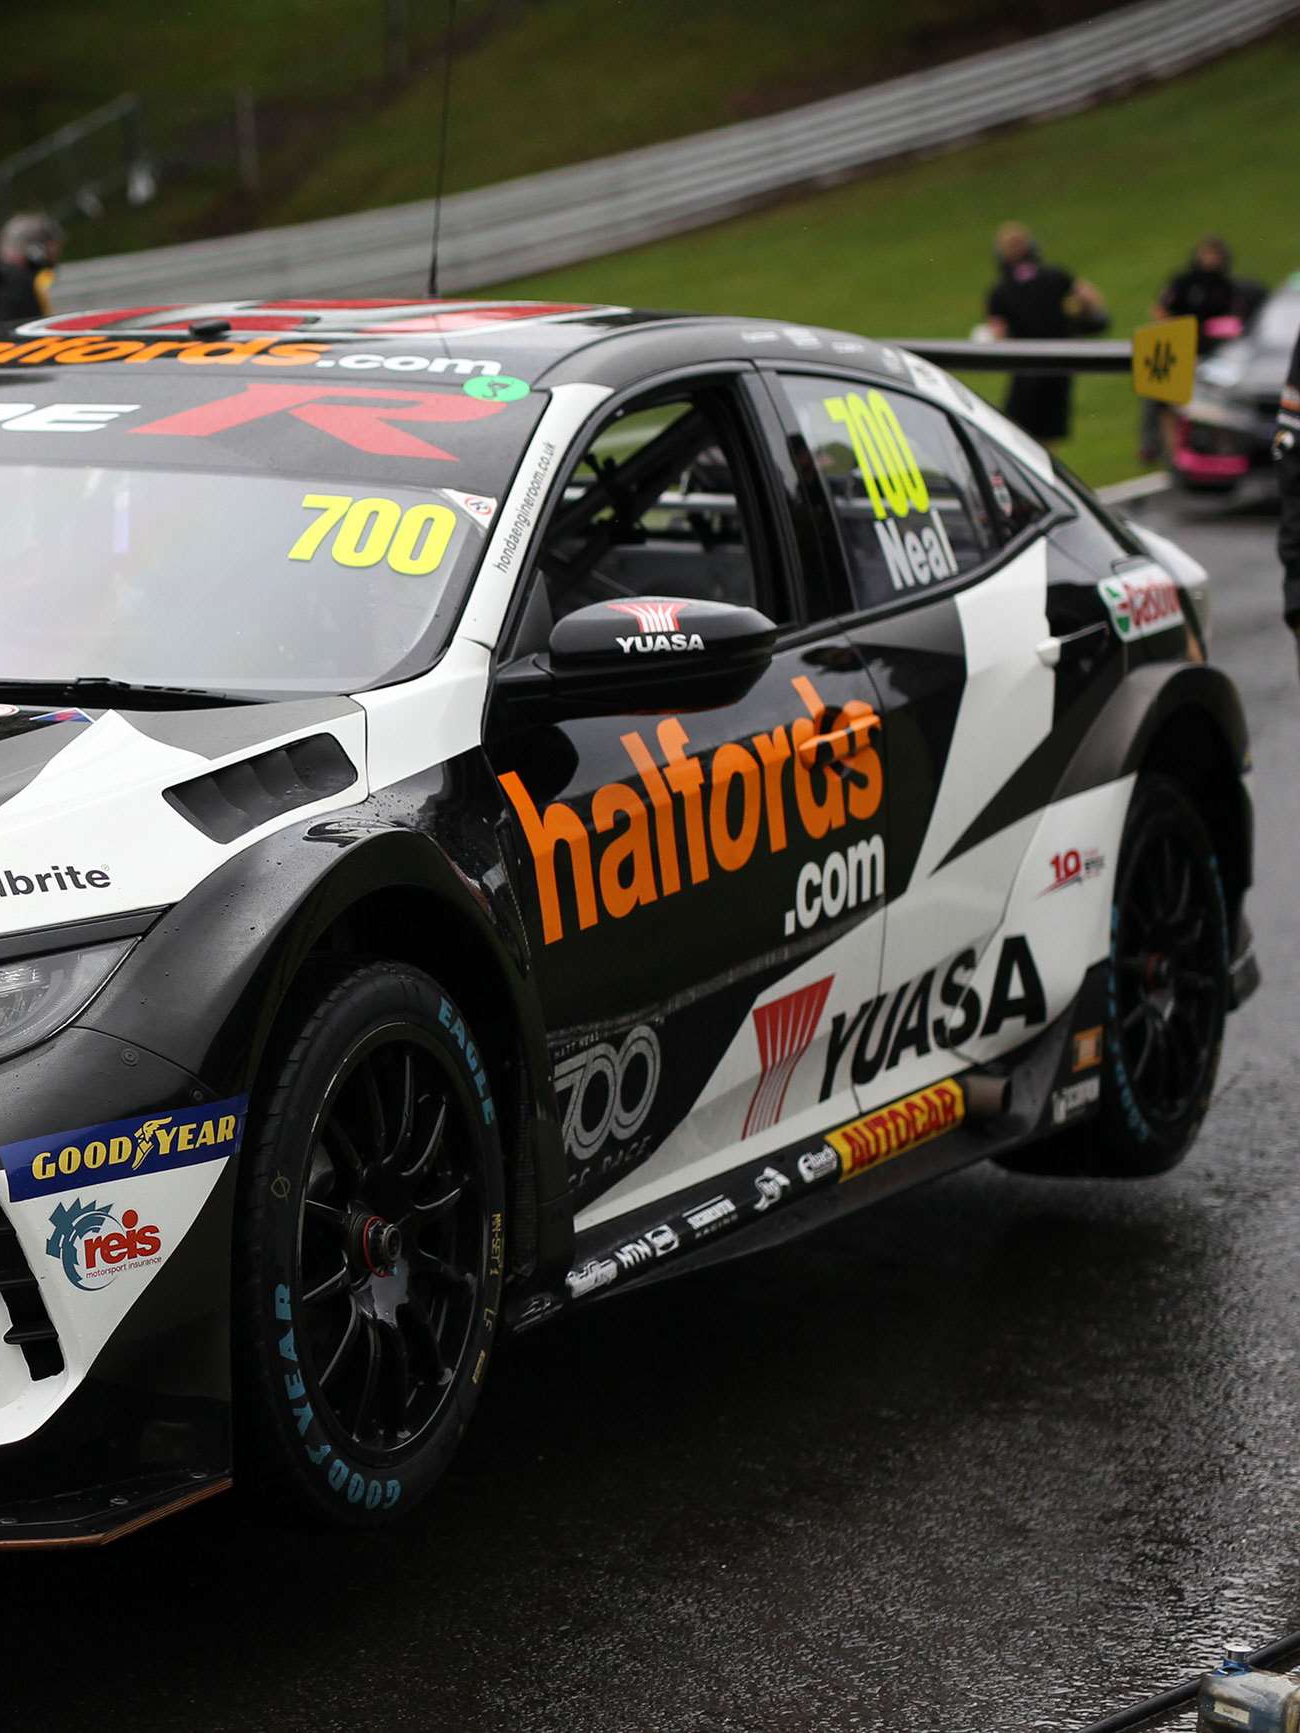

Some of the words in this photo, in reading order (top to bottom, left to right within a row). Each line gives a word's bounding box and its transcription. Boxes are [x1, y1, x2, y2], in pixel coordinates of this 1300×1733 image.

[127, 383, 507, 462] R
[823, 388, 930, 520] 700
[287, 494, 457, 576] 700
[493, 441, 556, 574] hondaengineroom.co.uk
[874, 508, 958, 591] Neal
[615, 633, 706, 653] YUASA
[498, 676, 884, 946] halfords
[784, 833, 886, 937] .com
[439, 996, 496, 1126] EAGLE
[819, 935, 1047, 1104] YUASA
[553, 1024, 661, 1161] 700
[841, 1086, 958, 1176] AUTOCAR
[84, 1209, 161, 1270] reis
[86, 1264, 127, 1279] motorsport
[128, 1256, 162, 1270] insurance
